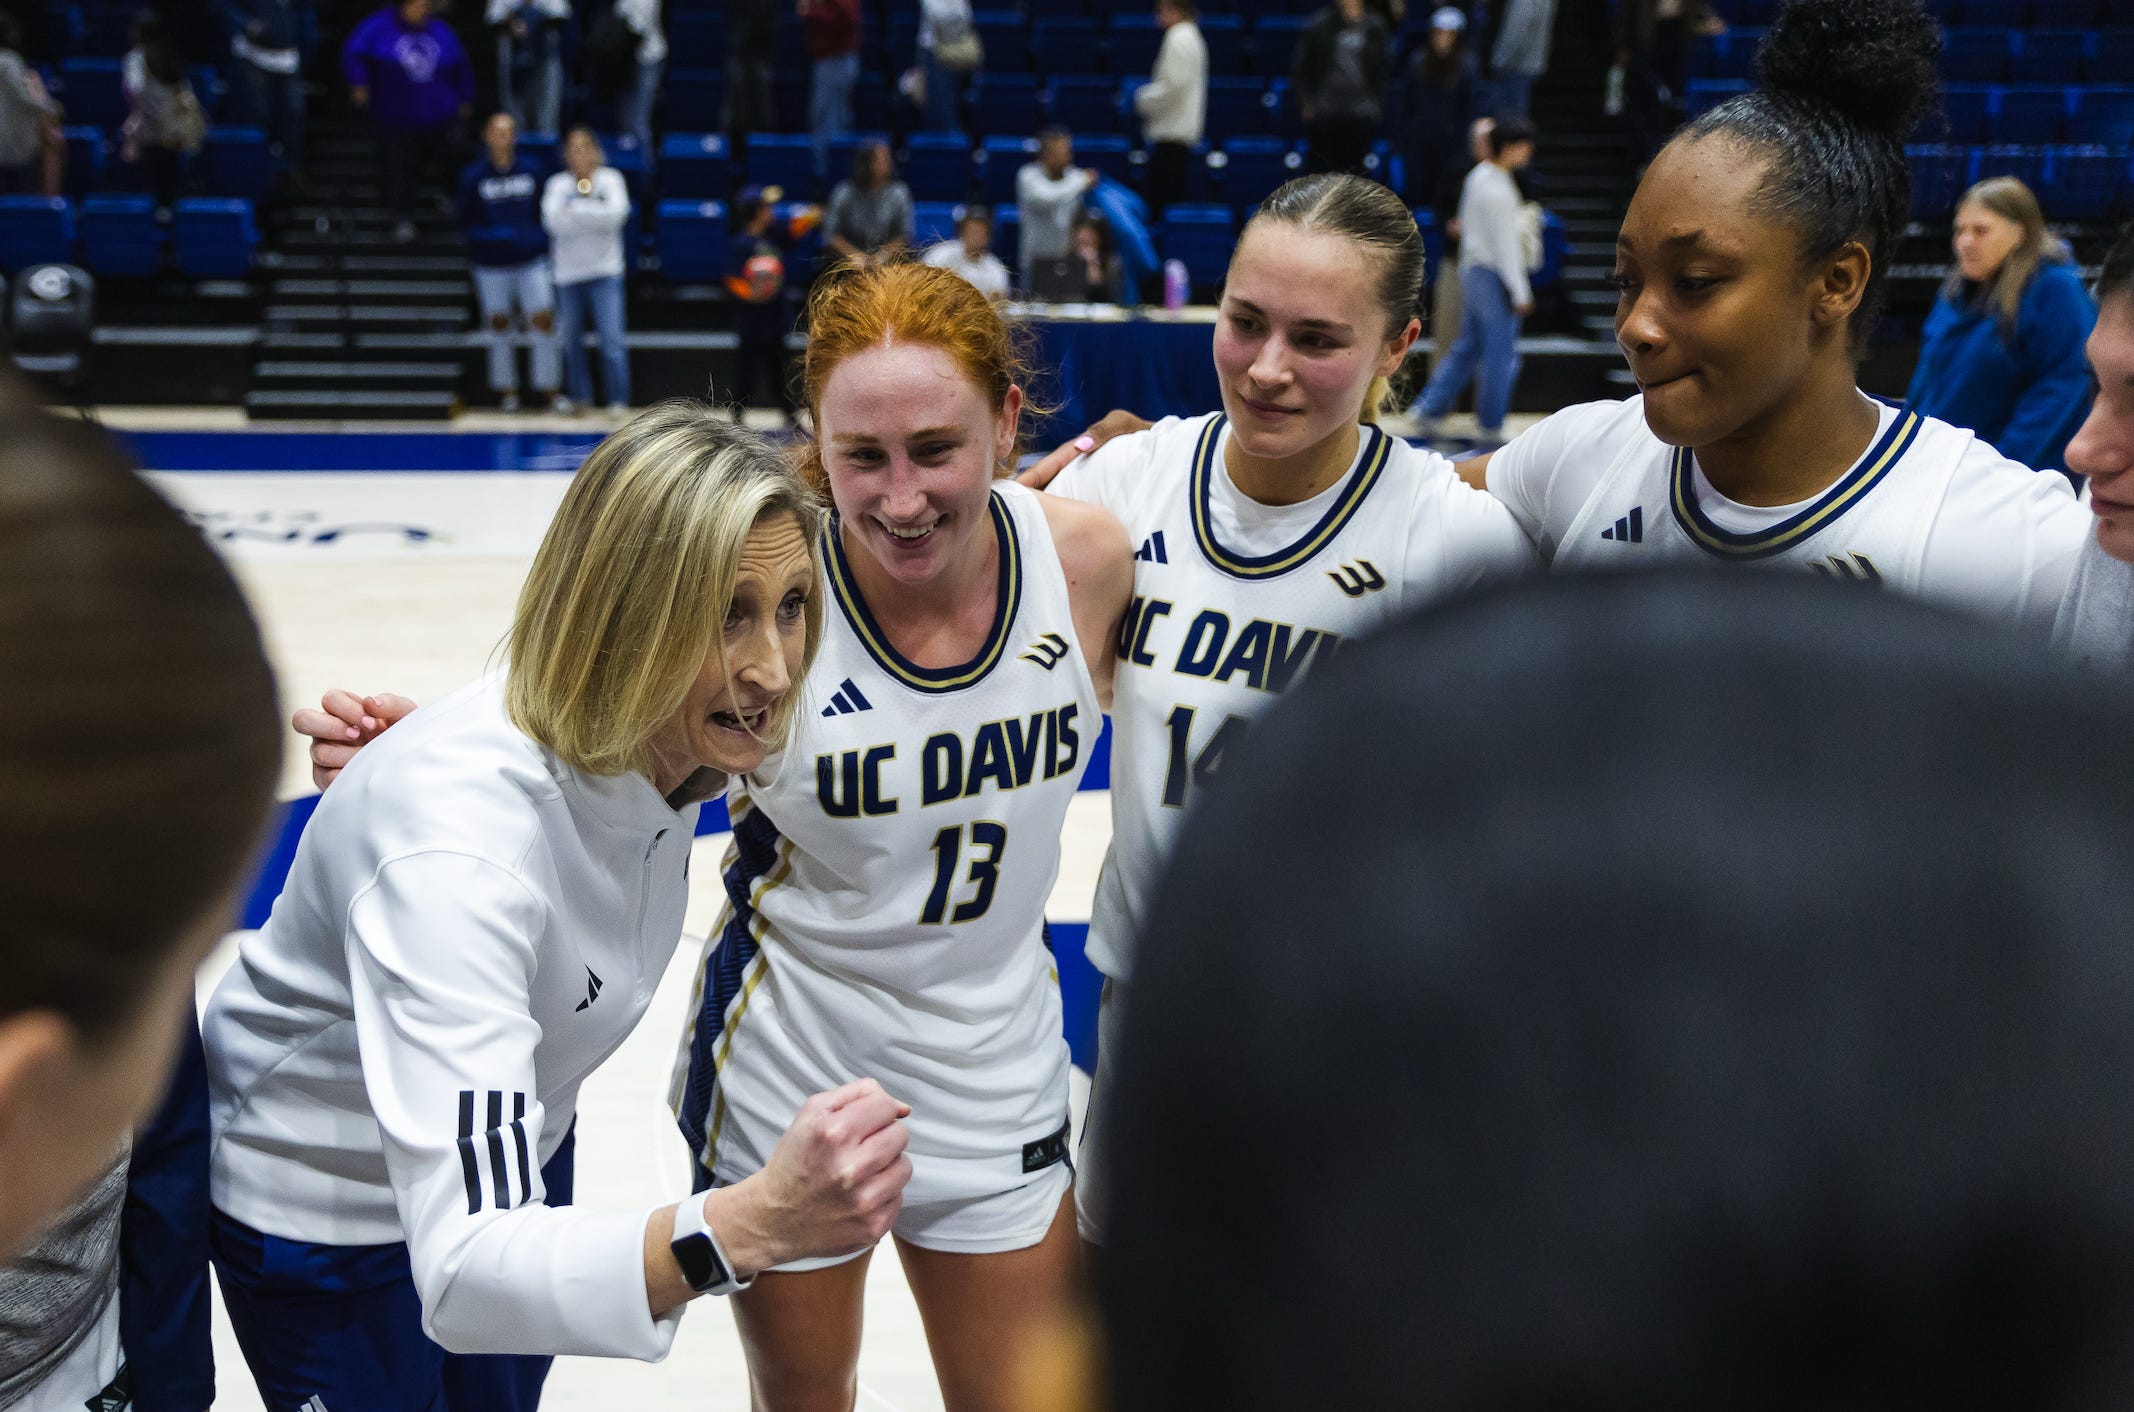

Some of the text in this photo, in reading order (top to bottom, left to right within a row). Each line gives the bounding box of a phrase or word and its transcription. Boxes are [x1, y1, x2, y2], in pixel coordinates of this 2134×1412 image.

[816, 702, 1079, 818] UC DAVIS
[917, 820, 1007, 925] 13
